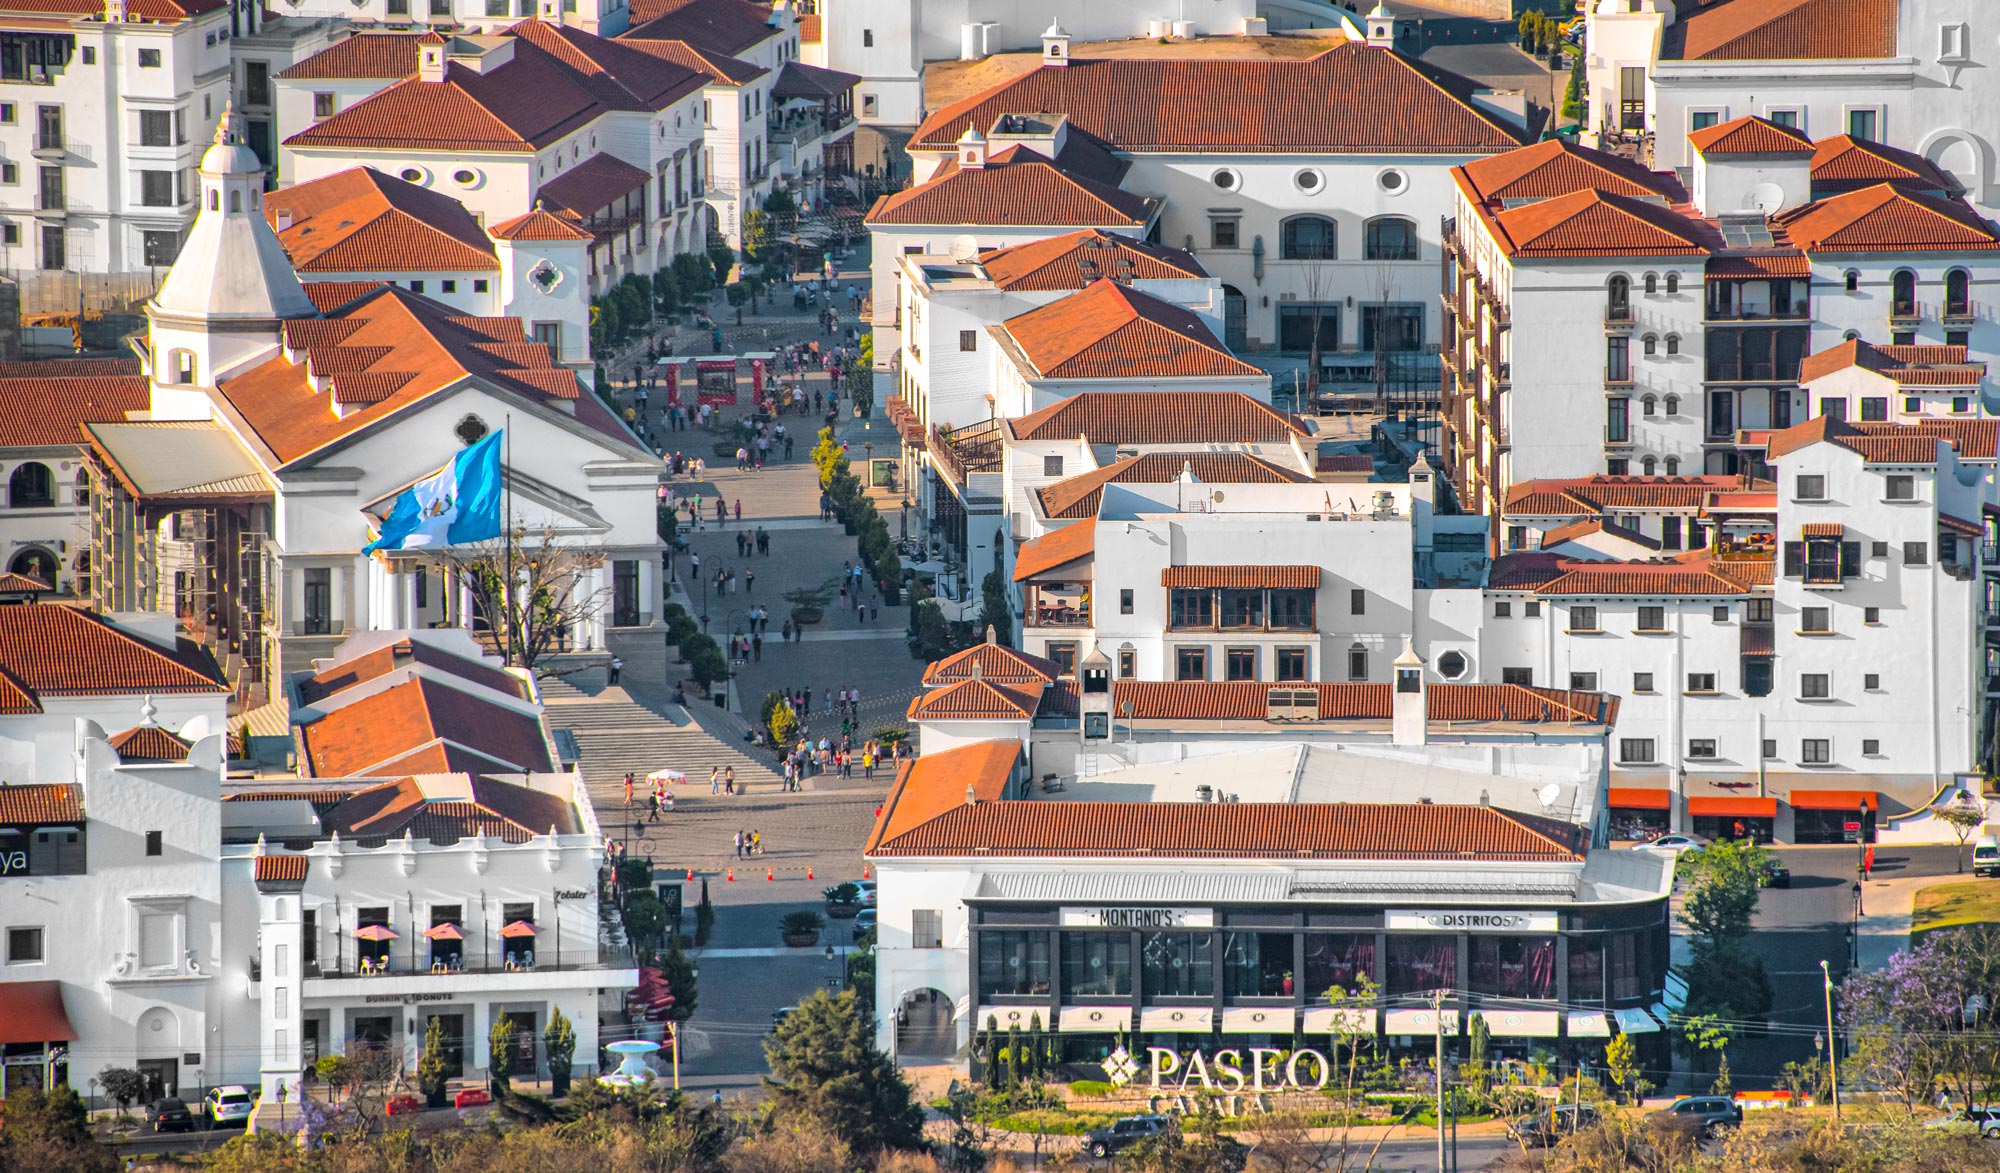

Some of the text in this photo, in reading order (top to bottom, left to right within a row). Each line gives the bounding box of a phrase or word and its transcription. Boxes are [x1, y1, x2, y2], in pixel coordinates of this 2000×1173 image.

[1100, 909, 1172, 926] MONTANO'S
[416, 993, 453, 1001] DONUTS
[1146, 1046, 1330, 1093] PASEO
